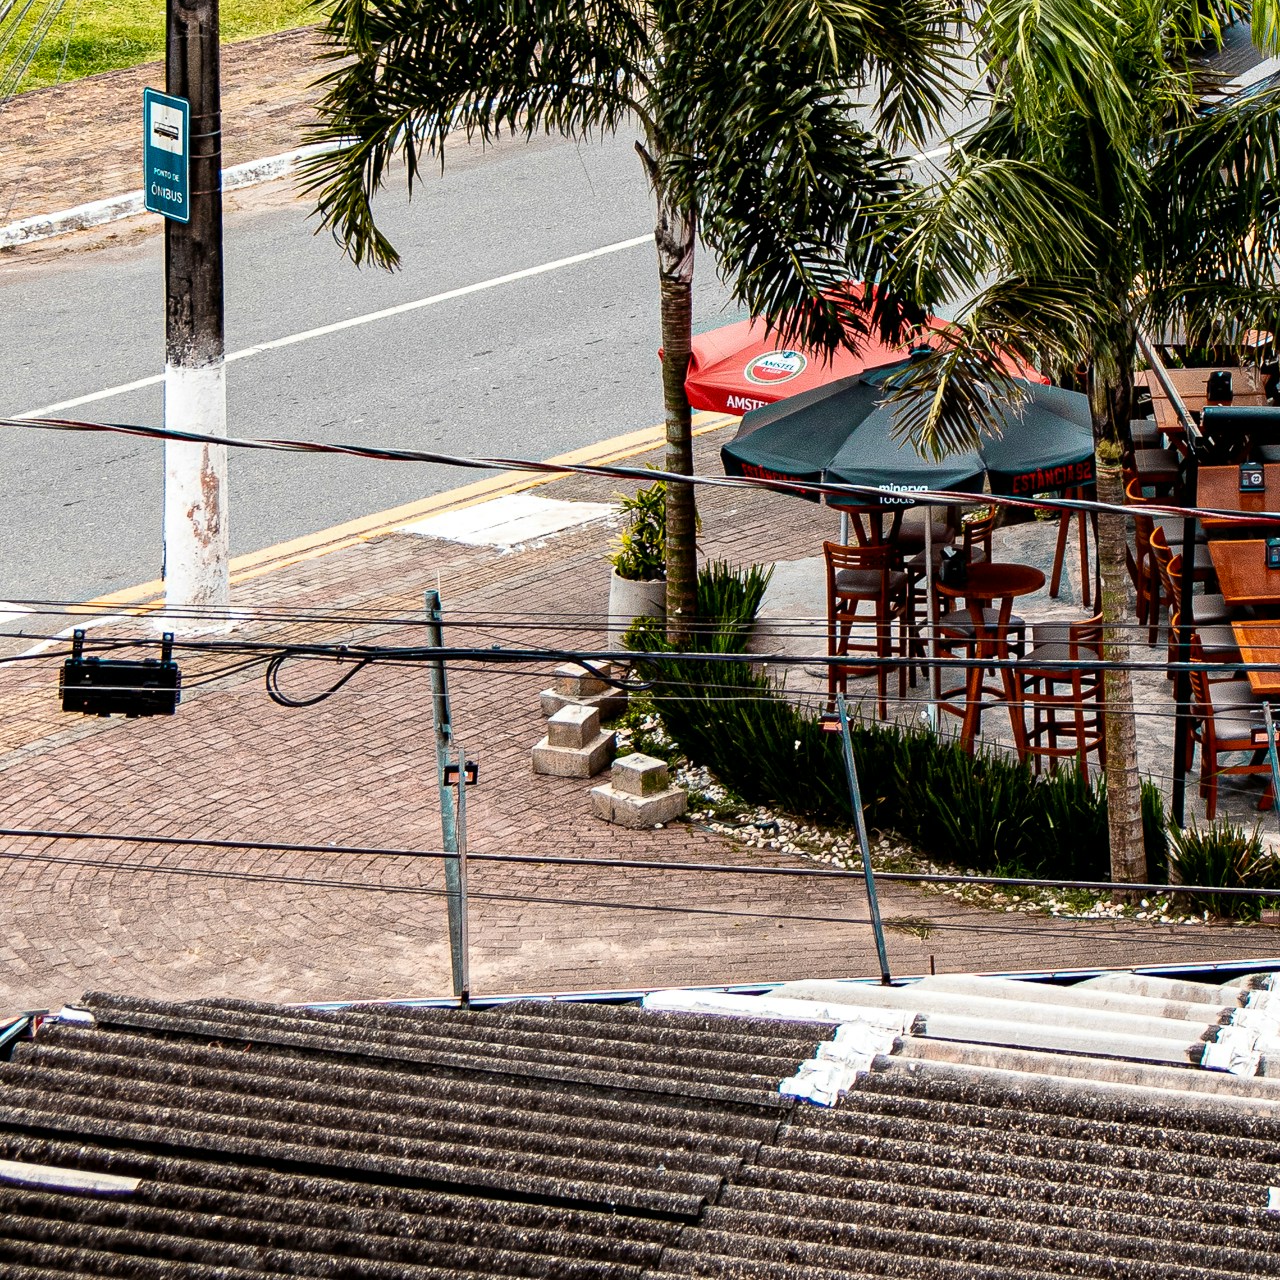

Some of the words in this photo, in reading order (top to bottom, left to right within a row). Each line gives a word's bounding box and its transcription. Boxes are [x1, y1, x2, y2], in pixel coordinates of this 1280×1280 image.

[153, 167, 171, 180] PONTO
[172, 173, 180, 183] DE
[761, 360, 796, 371] AMSTEL
[726, 394, 770, 411] AMSTE
[1012, 464, 1074, 494] ESTÂNCIA
[1075, 461, 1092, 479] 92
[878, 482, 929, 493] minerva
